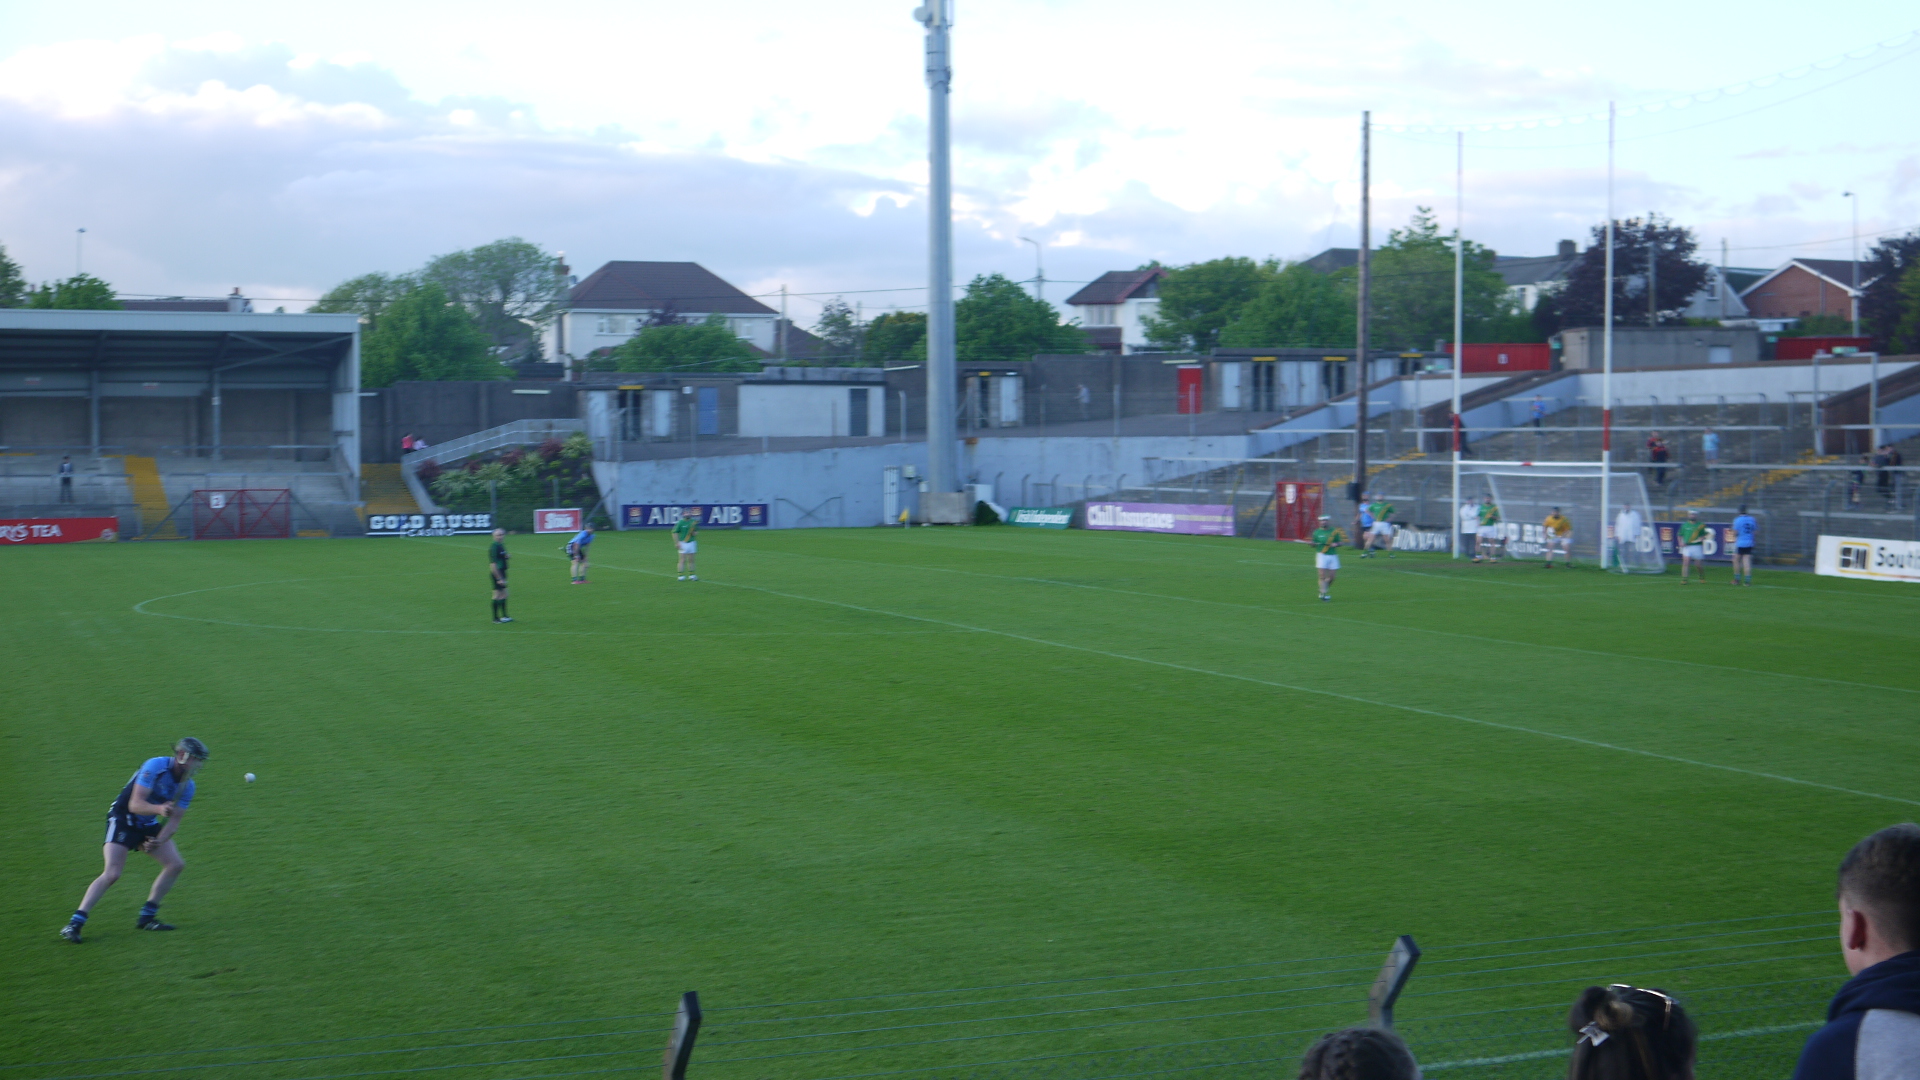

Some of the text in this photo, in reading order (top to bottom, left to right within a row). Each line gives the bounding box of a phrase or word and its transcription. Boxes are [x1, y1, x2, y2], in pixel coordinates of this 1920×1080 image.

[430, 514, 491, 528] RUSH
[648, 506, 683, 525] AIB
[708, 506, 743, 524] AIB
[30, 524, 63, 538] TEA
[407, 529, 454, 537] CASINO
